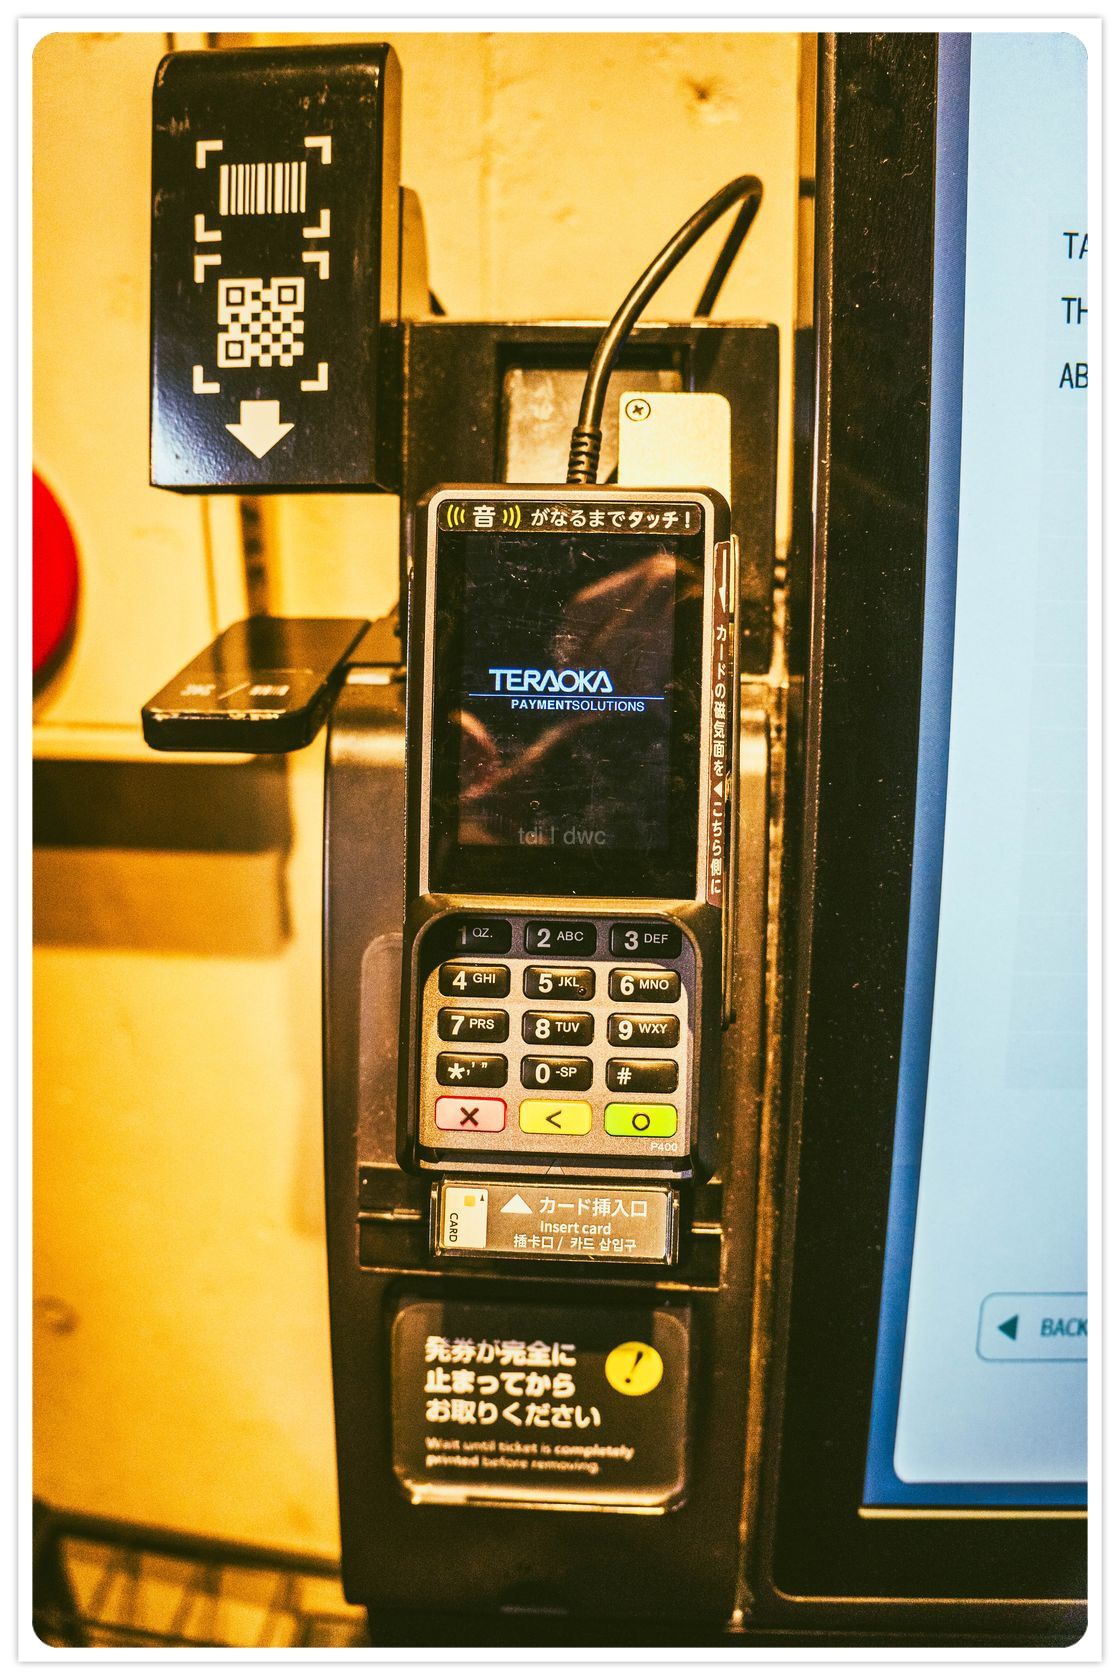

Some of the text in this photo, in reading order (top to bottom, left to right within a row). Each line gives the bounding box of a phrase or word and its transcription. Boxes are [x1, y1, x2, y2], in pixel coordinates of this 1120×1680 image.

[1059, 362, 1088, 389] AB
[472, 504, 496, 528] 音
[488, 668, 614, 693] TERAOKA
[511, 699, 645, 712] PAYMENTSOLUTIONS
[712, 624, 727, 777] カードの磁気面を
[458, 926, 467, 945] 1
[537, 928, 584, 948] 2 ABC
[624, 930, 669, 950] 3 DEF
[452, 971, 496, 991] 4 GHI
[538, 973, 580, 993] 5 JKL
[620, 975, 669, 995] 6 MNO
[450, 1016, 494, 1035] 7 PRS
[535, 1018, 580, 1039] 8 TUV
[618, 1020, 668, 1040] 9 WXY
[535, 1063, 550, 1084] 0
[650, 1142, 677, 1152] P400
[539, 1197, 648, 1217] カード挿入口
[449, 1212, 459, 1243] CARD
[540, 1221, 612, 1235] Insert card
[570, 1237, 595, 1250] 카드
[599, 1238, 636, 1252] 삽입구
[424, 1366, 576, 1399] 止まってから
[425, 1398, 601, 1429] お取りください
